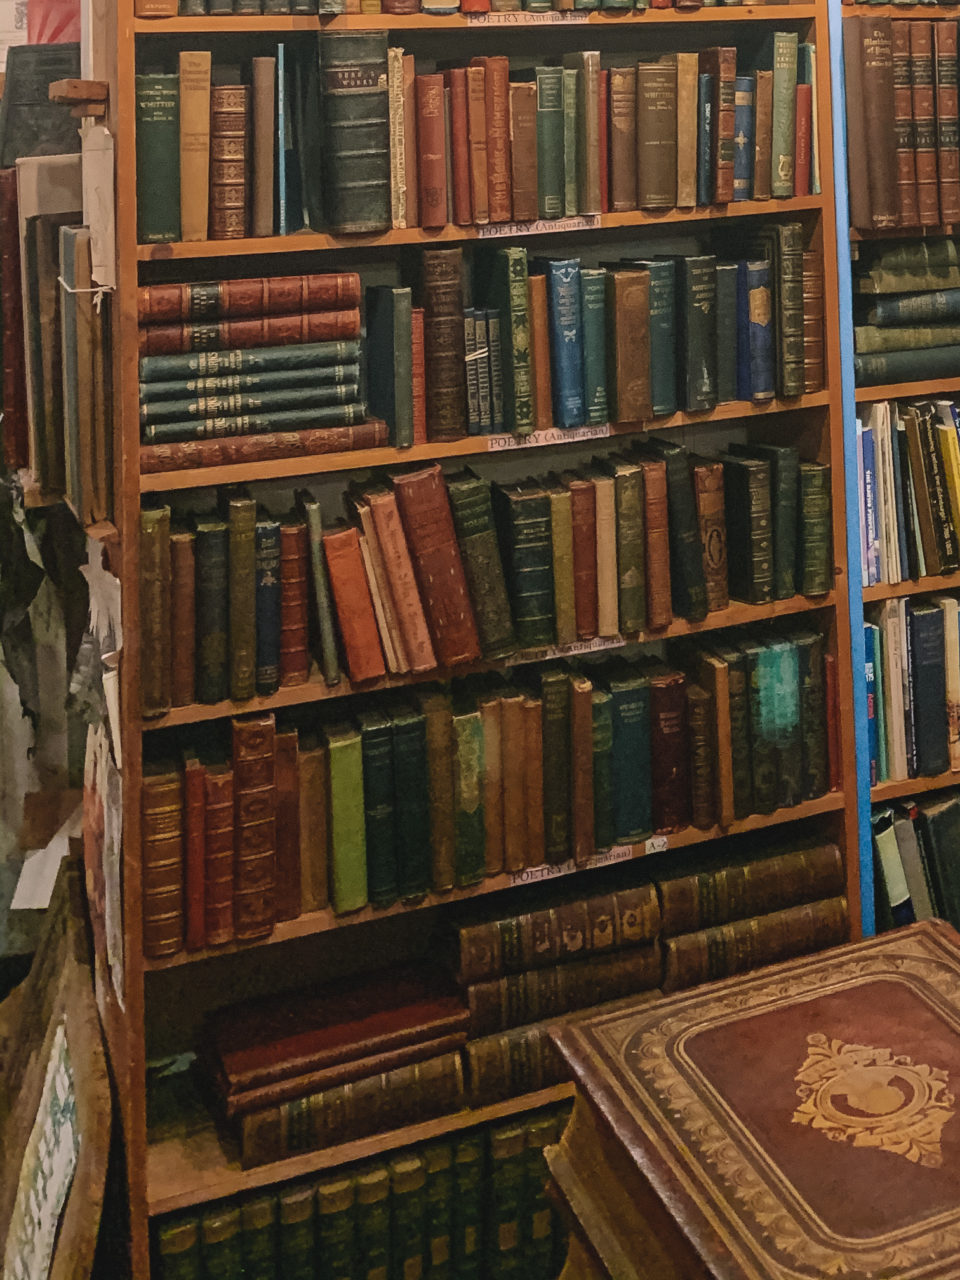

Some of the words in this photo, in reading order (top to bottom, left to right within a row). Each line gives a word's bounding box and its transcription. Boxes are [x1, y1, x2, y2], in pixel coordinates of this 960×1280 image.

[470, 13, 519, 24] POETRY
[481, 223, 531, 237] POETRY
[490, 433, 541, 448] POETRY
[544, 423, 609, 440] (Antiquarian)
[511, 864, 562, 883] POETRY
